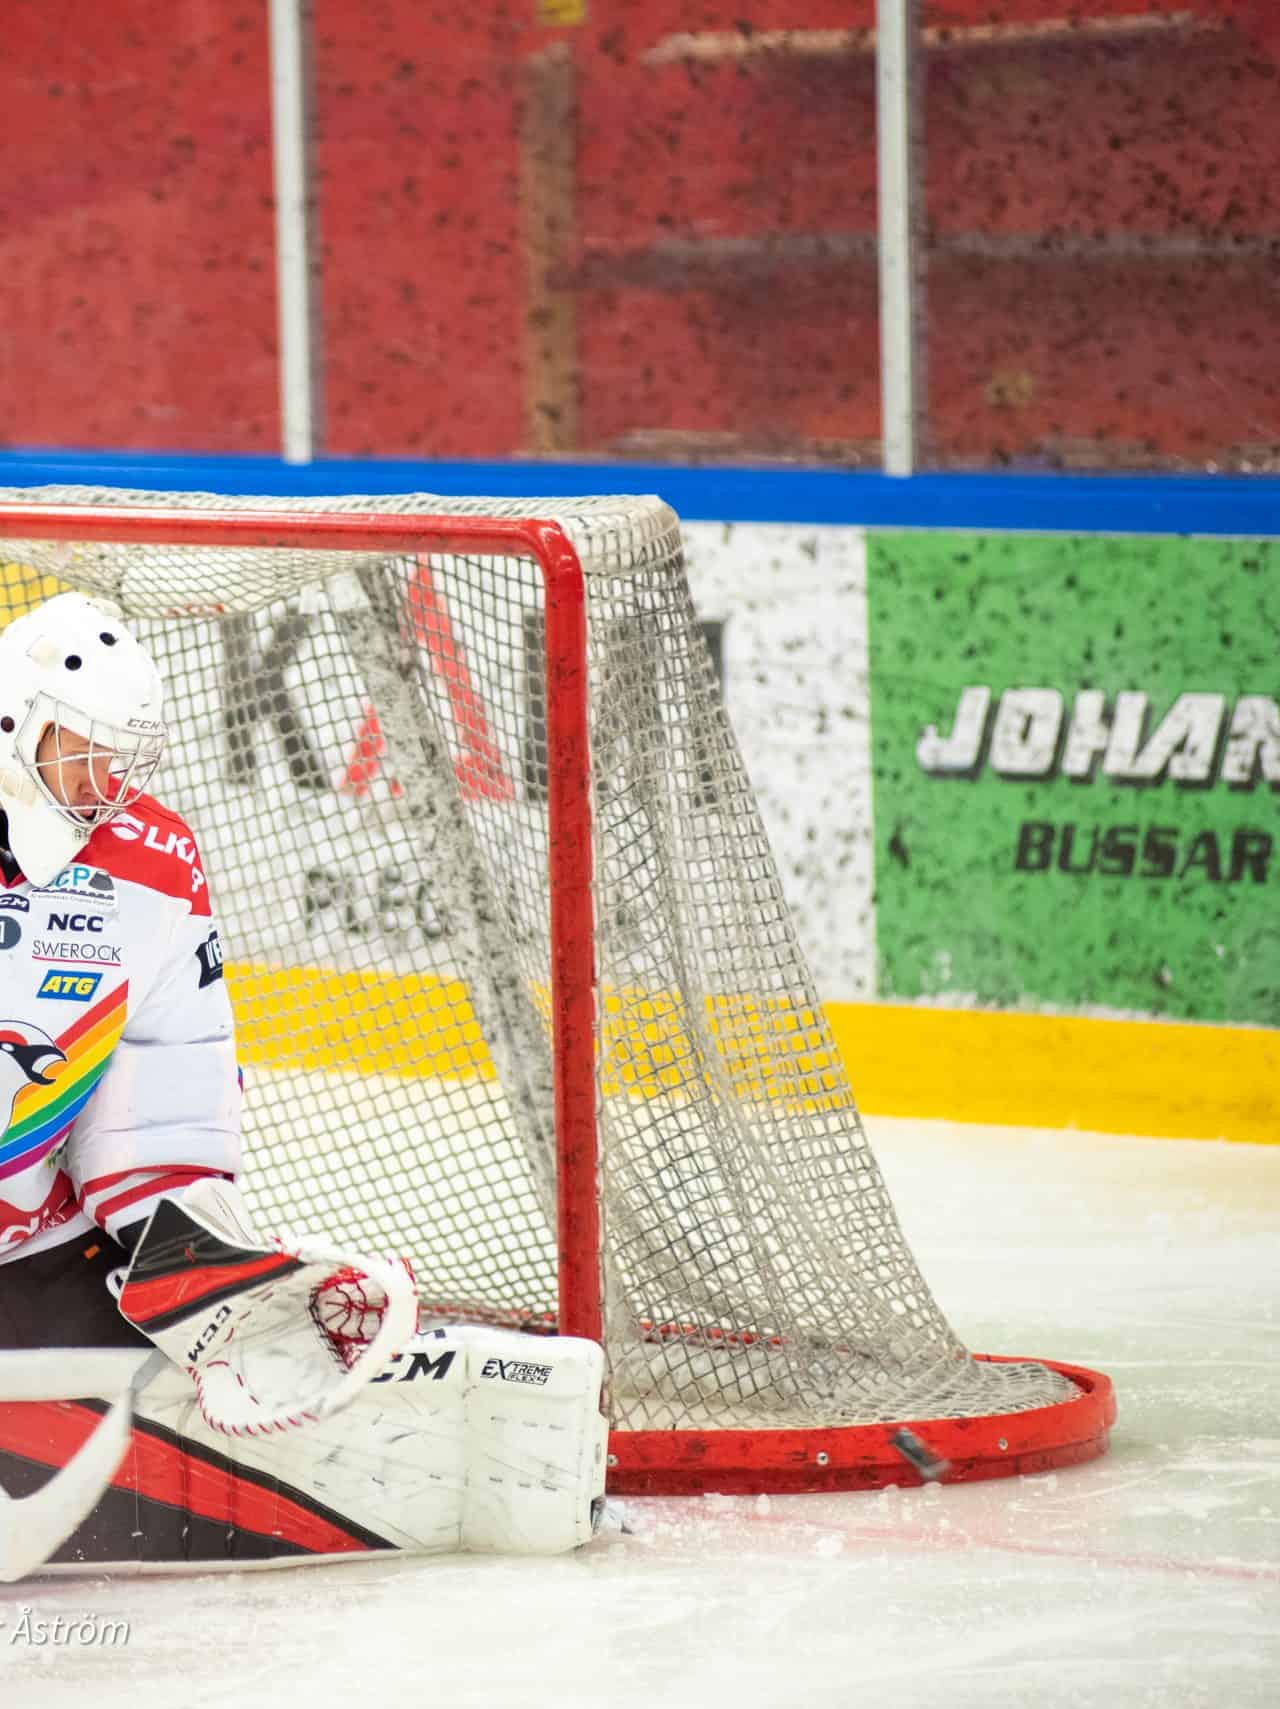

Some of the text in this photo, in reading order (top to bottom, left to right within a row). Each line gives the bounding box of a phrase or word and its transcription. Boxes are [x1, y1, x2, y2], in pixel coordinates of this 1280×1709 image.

[127, 717, 161, 730] CCM
[1015, 821, 1274, 884] BUSSAR
[47, 912, 104, 932] NCC
[32, 940, 121, 962] SWEROCK
[42, 975, 97, 996] ATG
[187, 1304, 233, 1363] CCM
[480, 1358, 554, 1382] EXTREME
